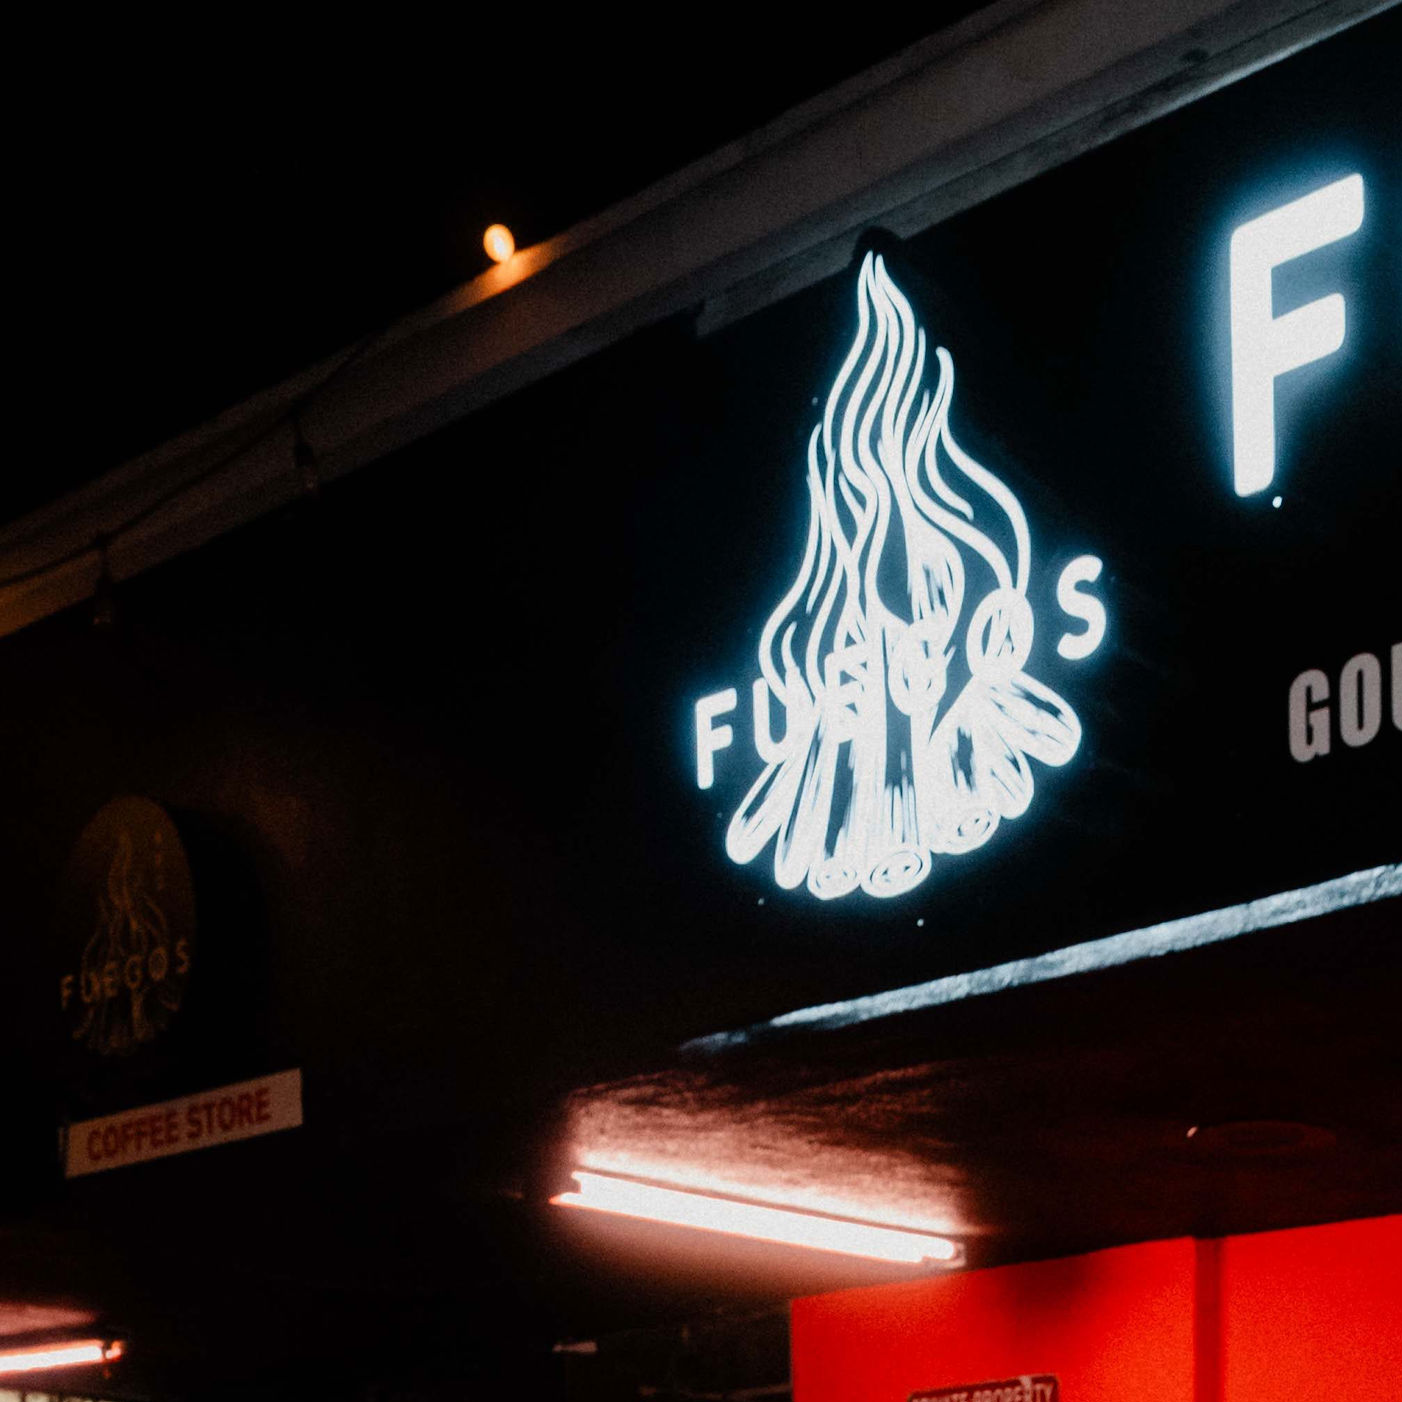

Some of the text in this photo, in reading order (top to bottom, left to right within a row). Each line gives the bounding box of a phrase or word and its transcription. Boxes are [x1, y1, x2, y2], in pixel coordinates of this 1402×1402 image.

[62, 938, 191, 1010] FUEGOS
[88, 1087, 270, 1160] COFFEE STORE
